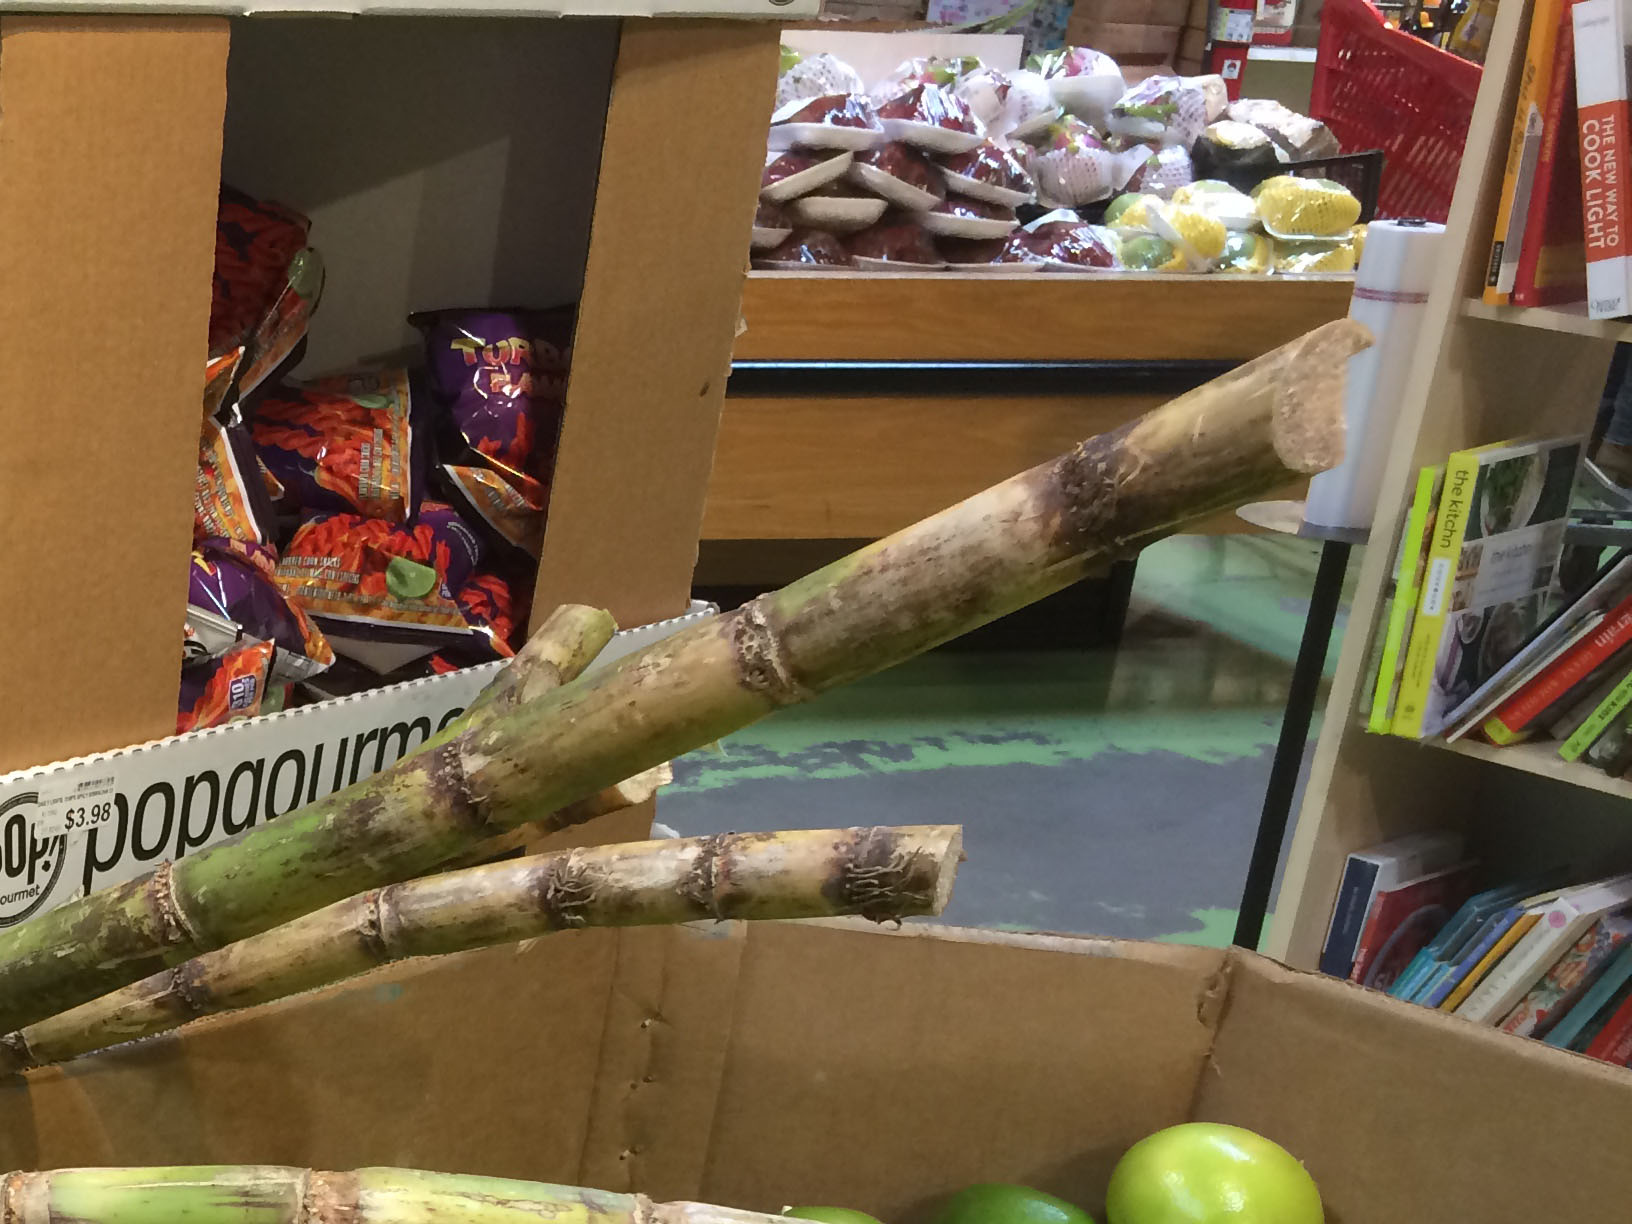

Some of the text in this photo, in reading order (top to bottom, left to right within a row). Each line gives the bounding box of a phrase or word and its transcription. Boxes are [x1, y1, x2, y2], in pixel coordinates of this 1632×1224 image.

[1582, 118, 1606, 249] COOK LIGHT
[1601, 114, 1619, 247] THE NEW WAY TO
[1439, 469, 1470, 549] the kitchn
[64, 801, 112, 831] $3.98
[81, 706, 467, 897] popgourm
